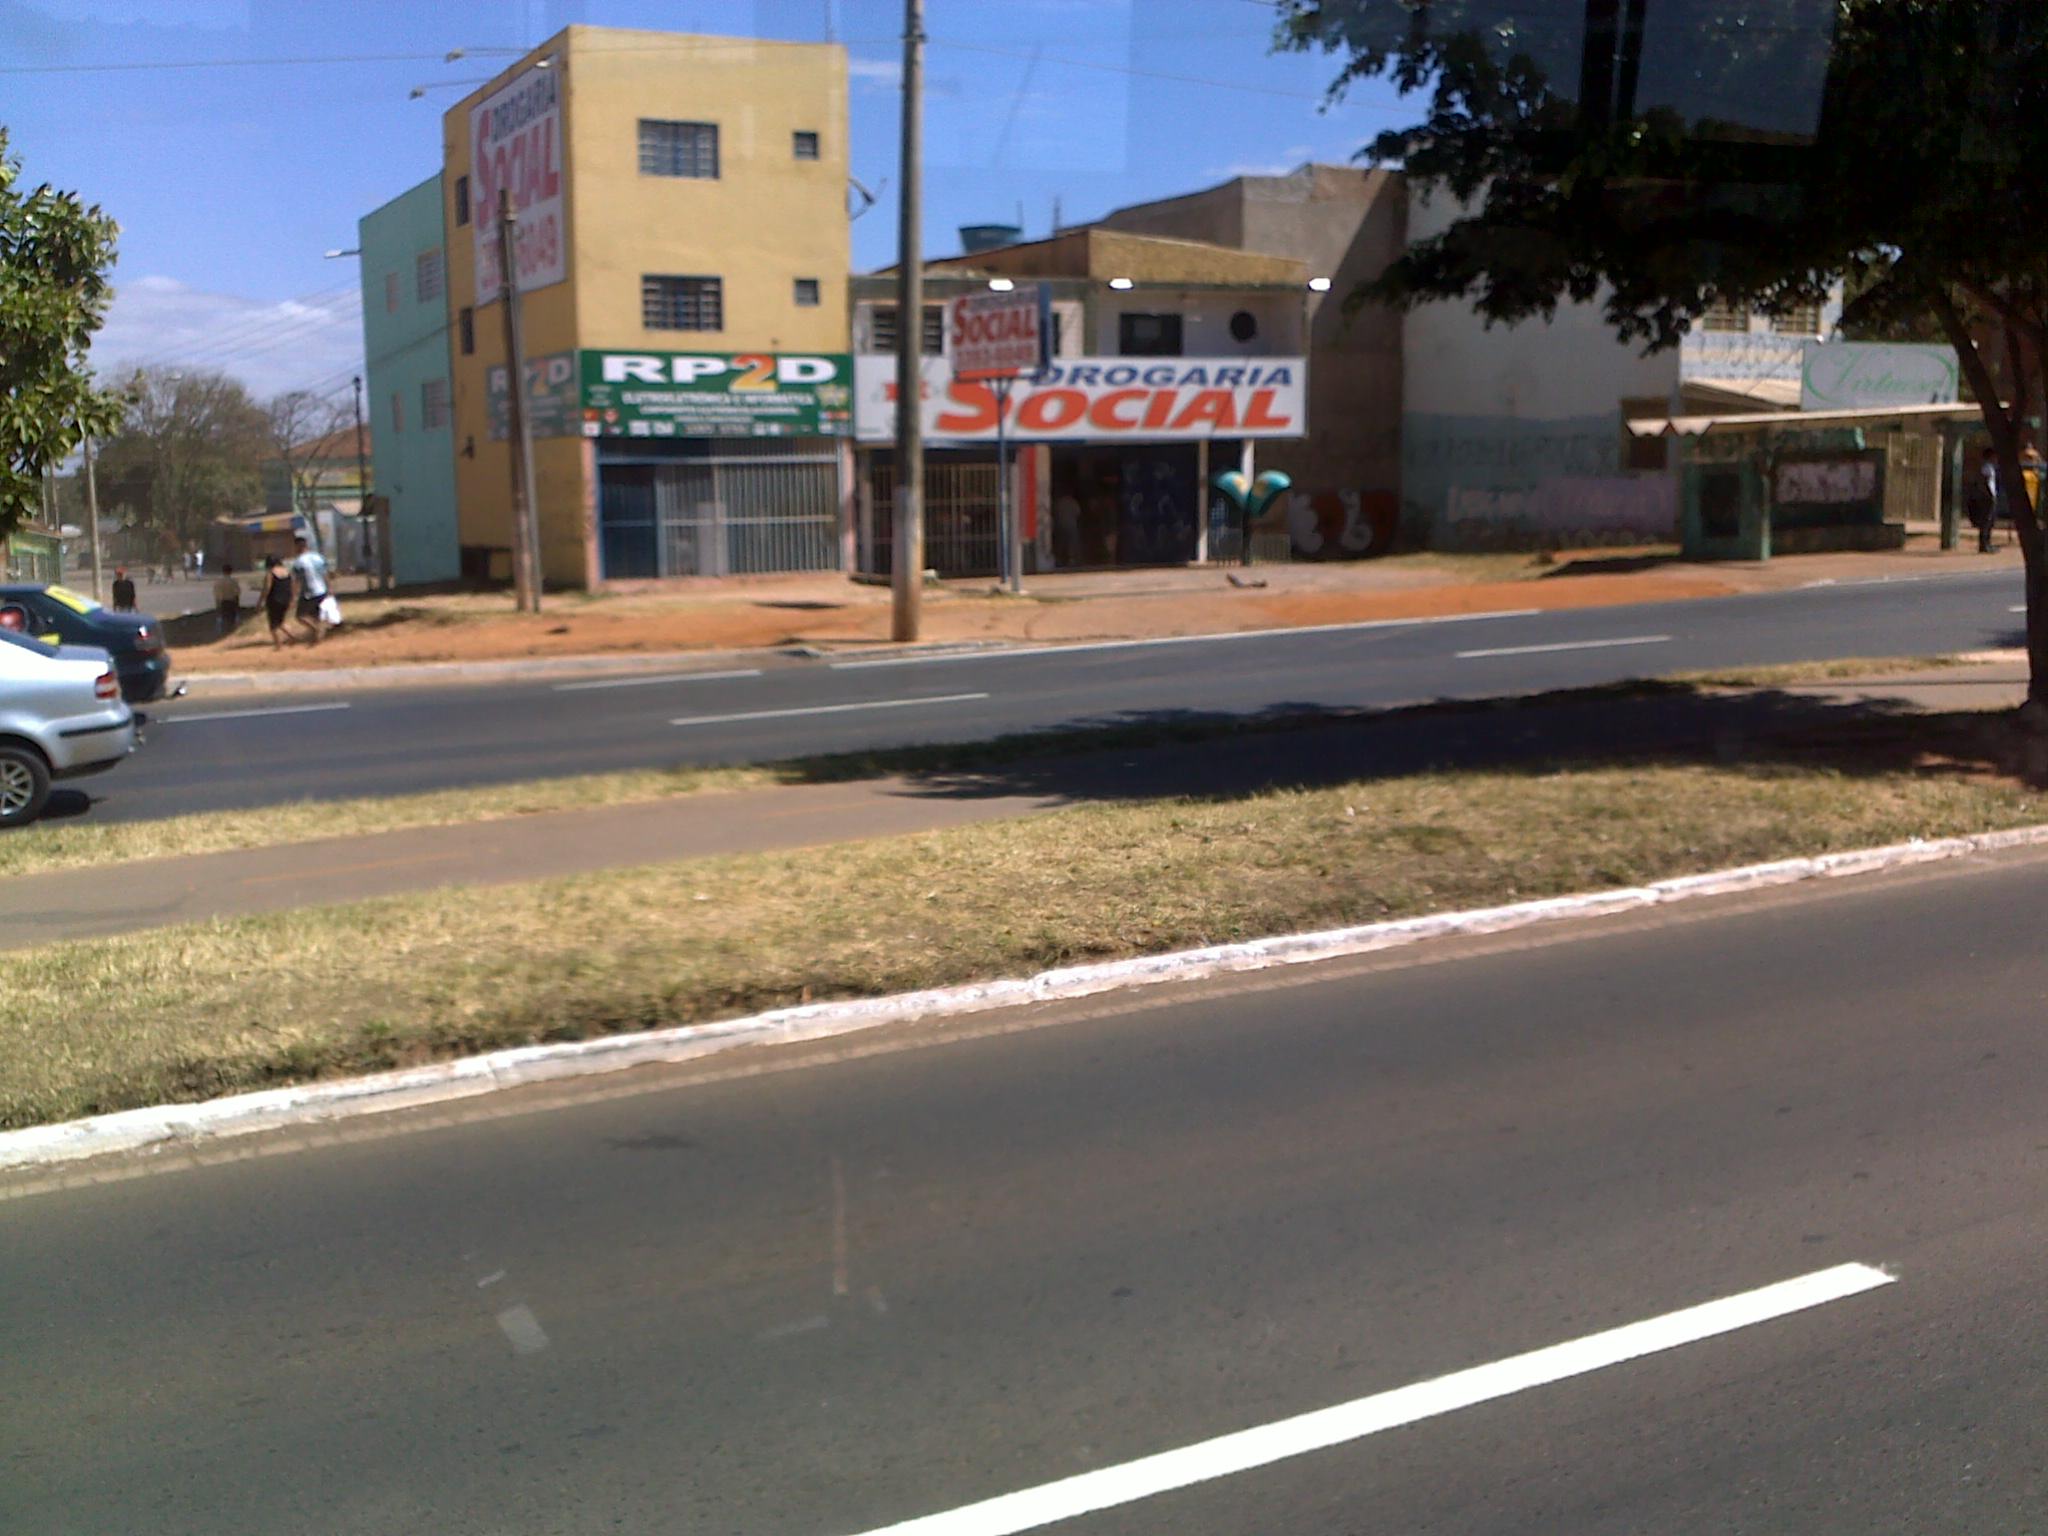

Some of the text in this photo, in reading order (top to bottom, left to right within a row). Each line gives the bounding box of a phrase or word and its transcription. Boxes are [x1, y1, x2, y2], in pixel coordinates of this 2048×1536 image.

[952, 297, 1036, 347] SOCIAL
[602, 353, 838, 393] RP2D
[1030, 365, 1293, 388] DROGARIA
[935, 377, 1293, 432] SOCIAL
